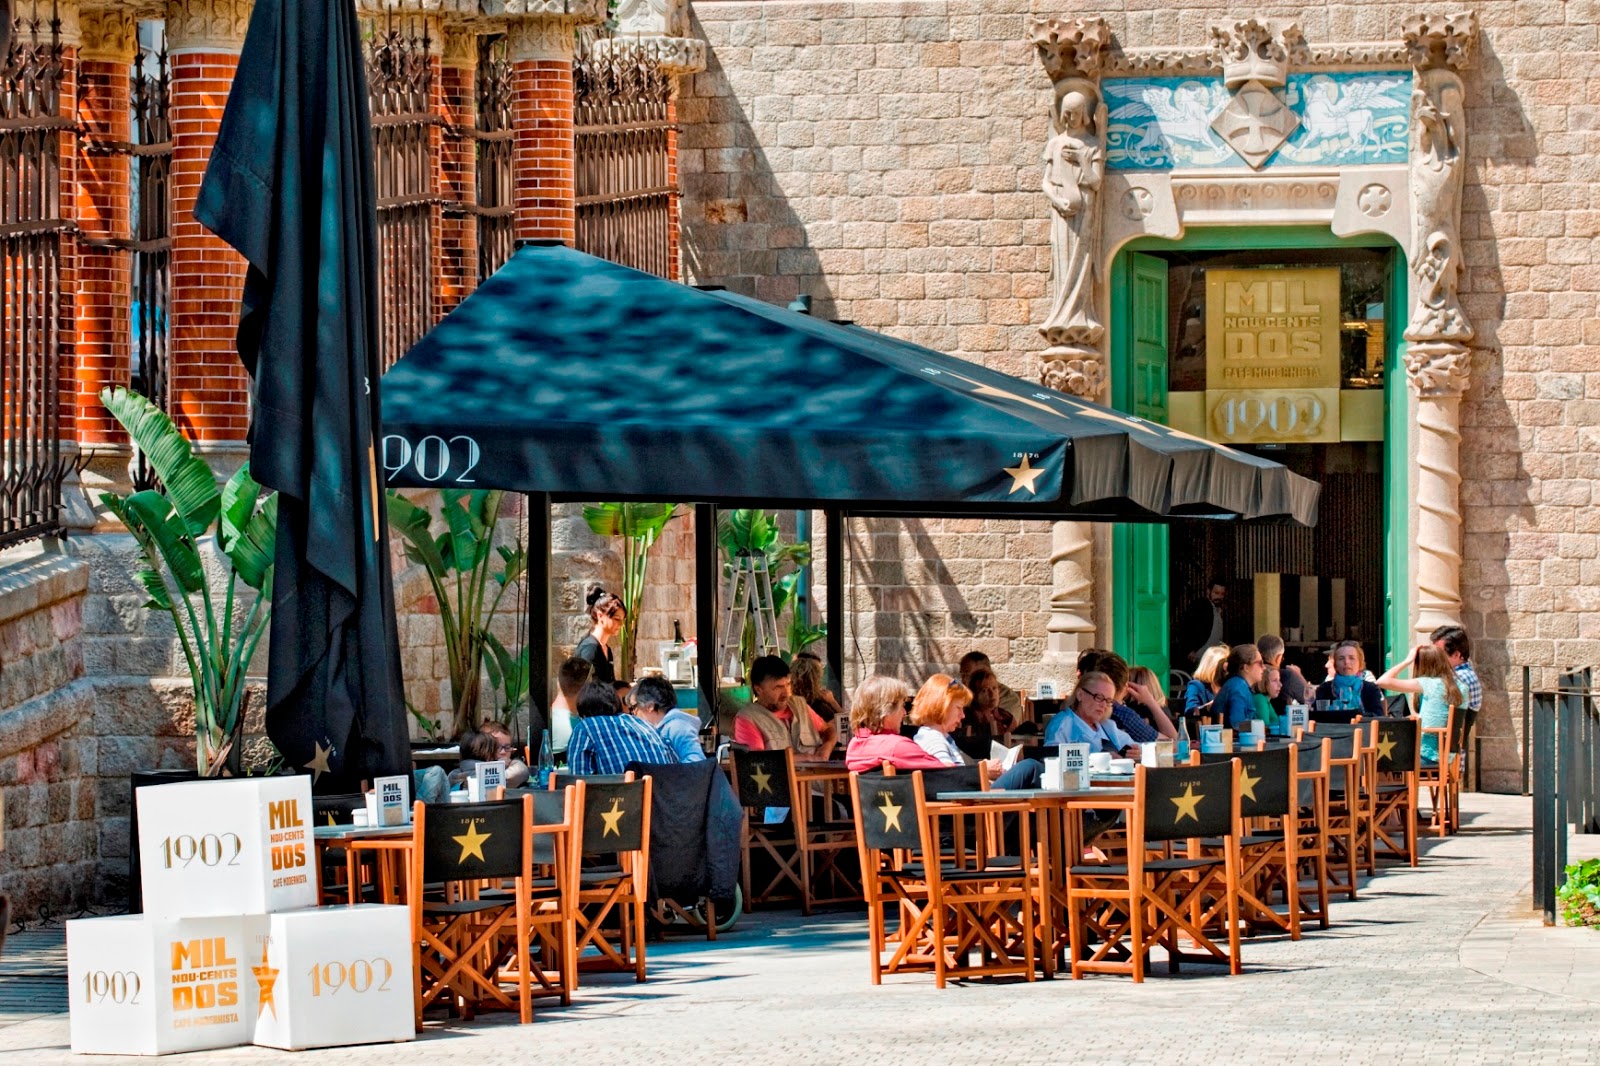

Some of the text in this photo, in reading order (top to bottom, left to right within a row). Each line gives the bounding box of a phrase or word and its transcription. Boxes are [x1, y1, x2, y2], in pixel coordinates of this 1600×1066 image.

[1224, 281, 1321, 313] MIL
[1224, 331, 1321, 359] DOS
[1222, 396, 1321, 435] 1902
[381, 435, 480, 482] 902
[1067, 749, 1082, 757] MIL
[1067, 760, 1083, 768] DOS
[383, 783, 401, 791] MIL
[269, 799, 304, 830] MIL
[159, 832, 242, 869] 1902
[271, 843, 306, 871] DOS
[283, 875, 308, 887] MODERNISTA
[170, 937, 237, 970] MIL
[82, 971, 141, 1005] 1902
[307, 957, 393, 997] 1902
[172, 981, 238, 1011] DOS
